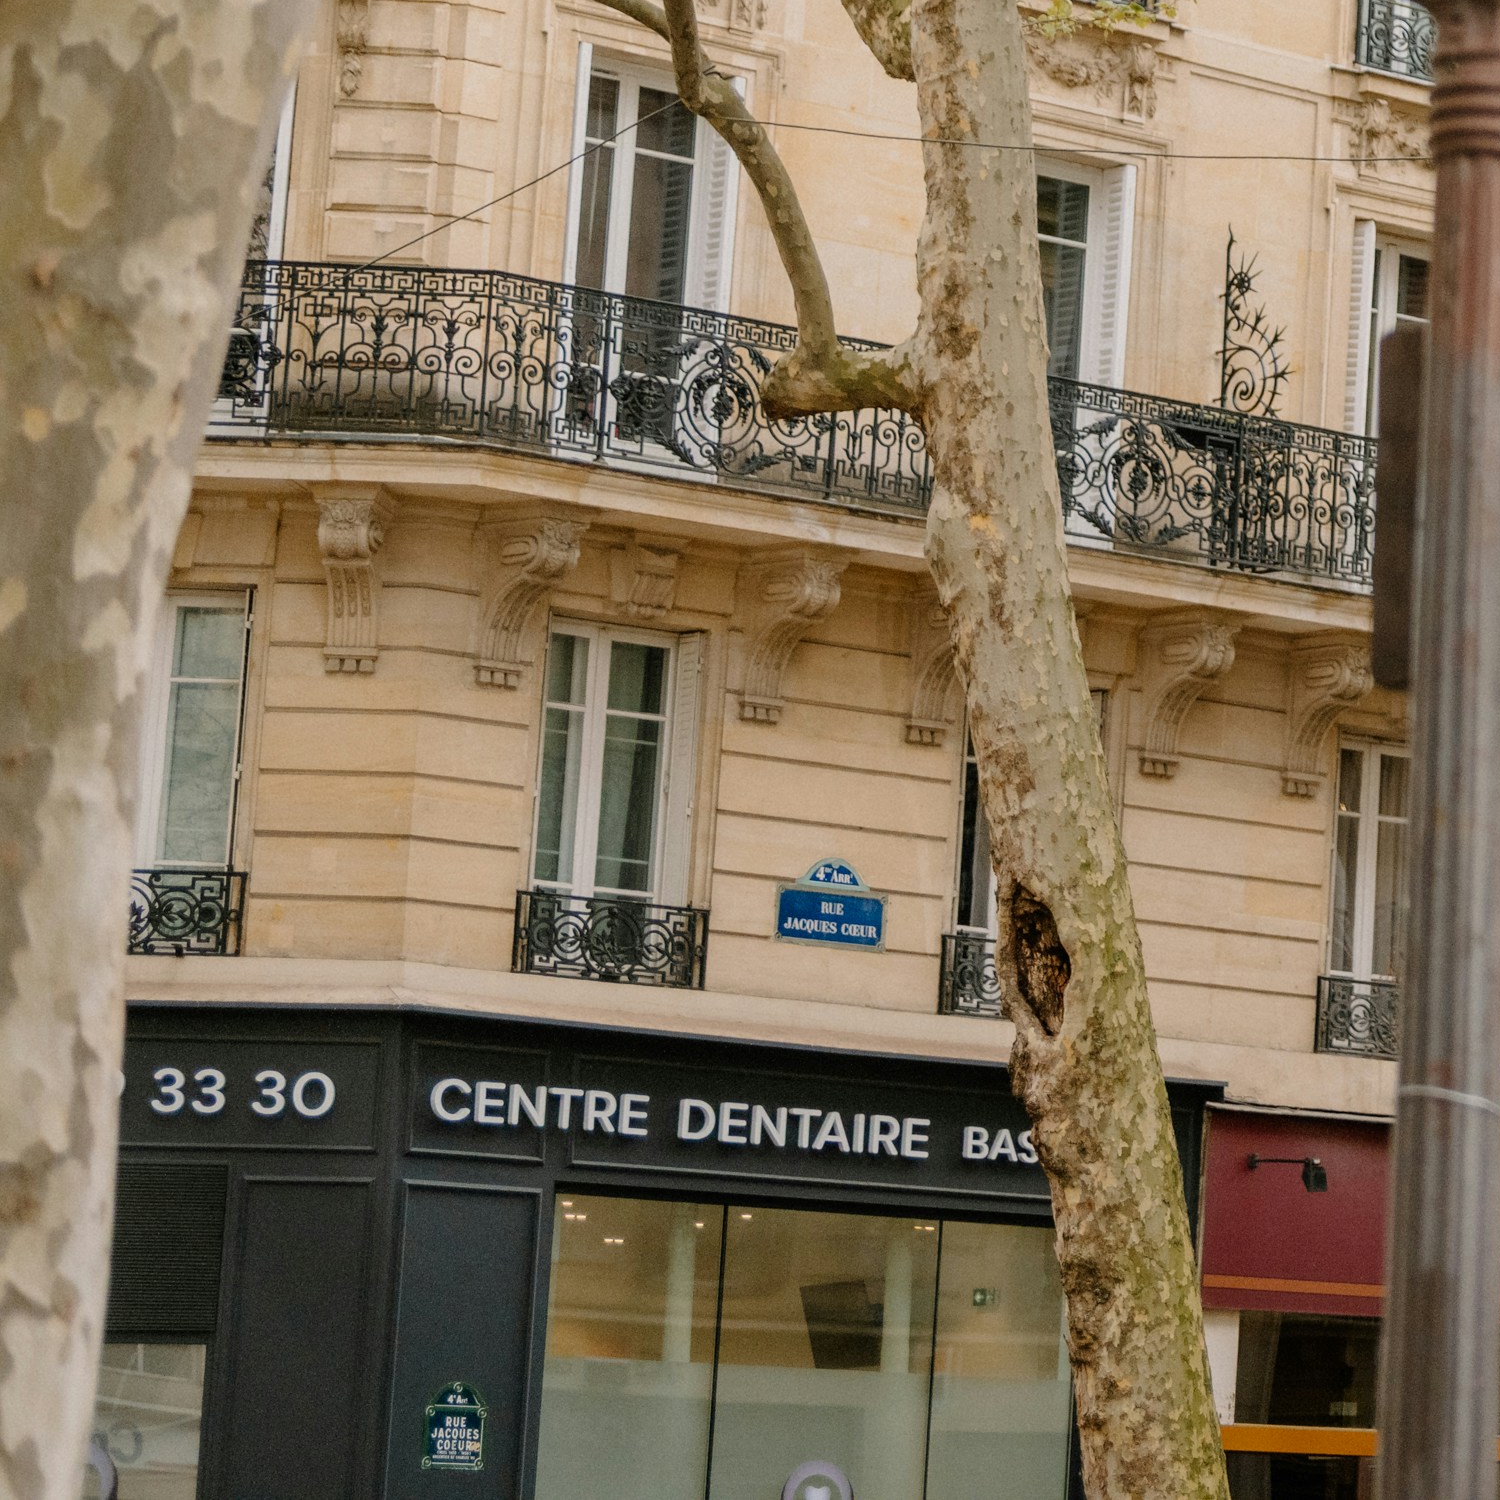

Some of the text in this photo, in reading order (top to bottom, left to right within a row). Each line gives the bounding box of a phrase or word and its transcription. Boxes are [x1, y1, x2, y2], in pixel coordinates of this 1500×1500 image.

[821, 901, 844, 915] RUE
[783, 917, 878, 938] JACQUES CŒUR
[150, 1067, 227, 1113] 33
[251, 1070, 336, 1117] 30
[429, 1077, 650, 1136] CENTRE
[677, 1098, 931, 1160] DENTAIRE
[445, 1416, 467, 1427] RUE
[431, 1428, 480, 1439] JACQUES
[436, 1439, 472, 1451] COEUR
